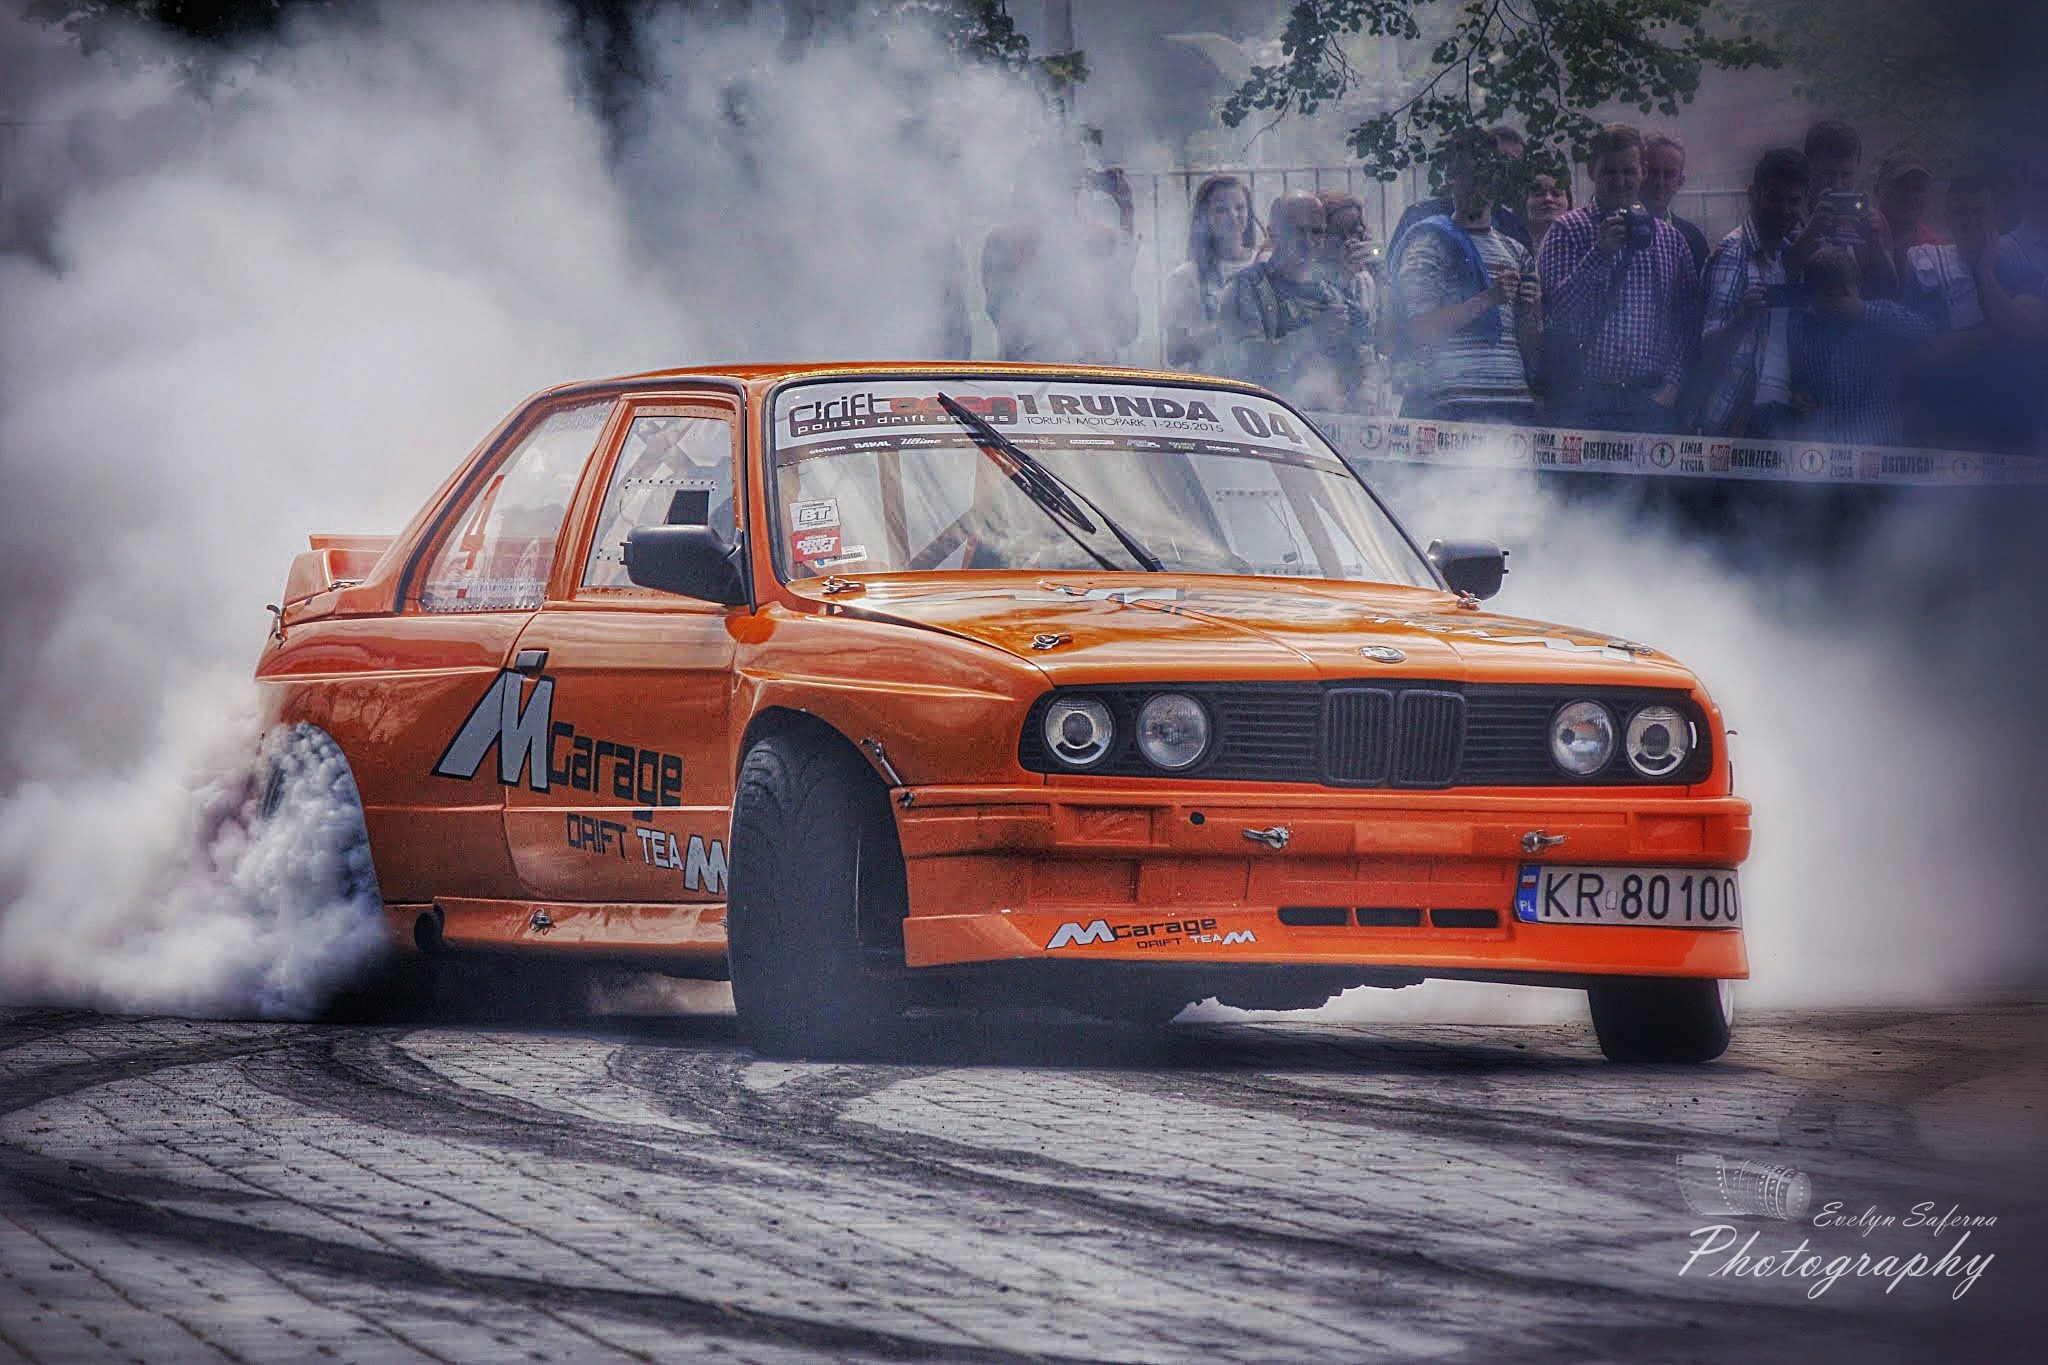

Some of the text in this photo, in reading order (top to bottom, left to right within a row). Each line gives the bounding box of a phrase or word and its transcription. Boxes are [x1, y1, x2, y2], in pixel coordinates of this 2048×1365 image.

[1017, 394, 1220, 422] 1 RUNDA
[797, 418, 866, 434] polish
[877, 414, 926, 424] drift
[1076, 417, 1147, 427] MOTOPARK
[1231, 405, 1302, 445] 04
[459, 475, 505, 570] 4
[799, 506, 832, 523] BT
[566, 812, 729, 895] DRIFT TEAM
[1519, 899, 1534, 913] PL
[1544, 872, 1605, 919] KR
[1136, 929, 1258, 950] DRIFT TEAM
